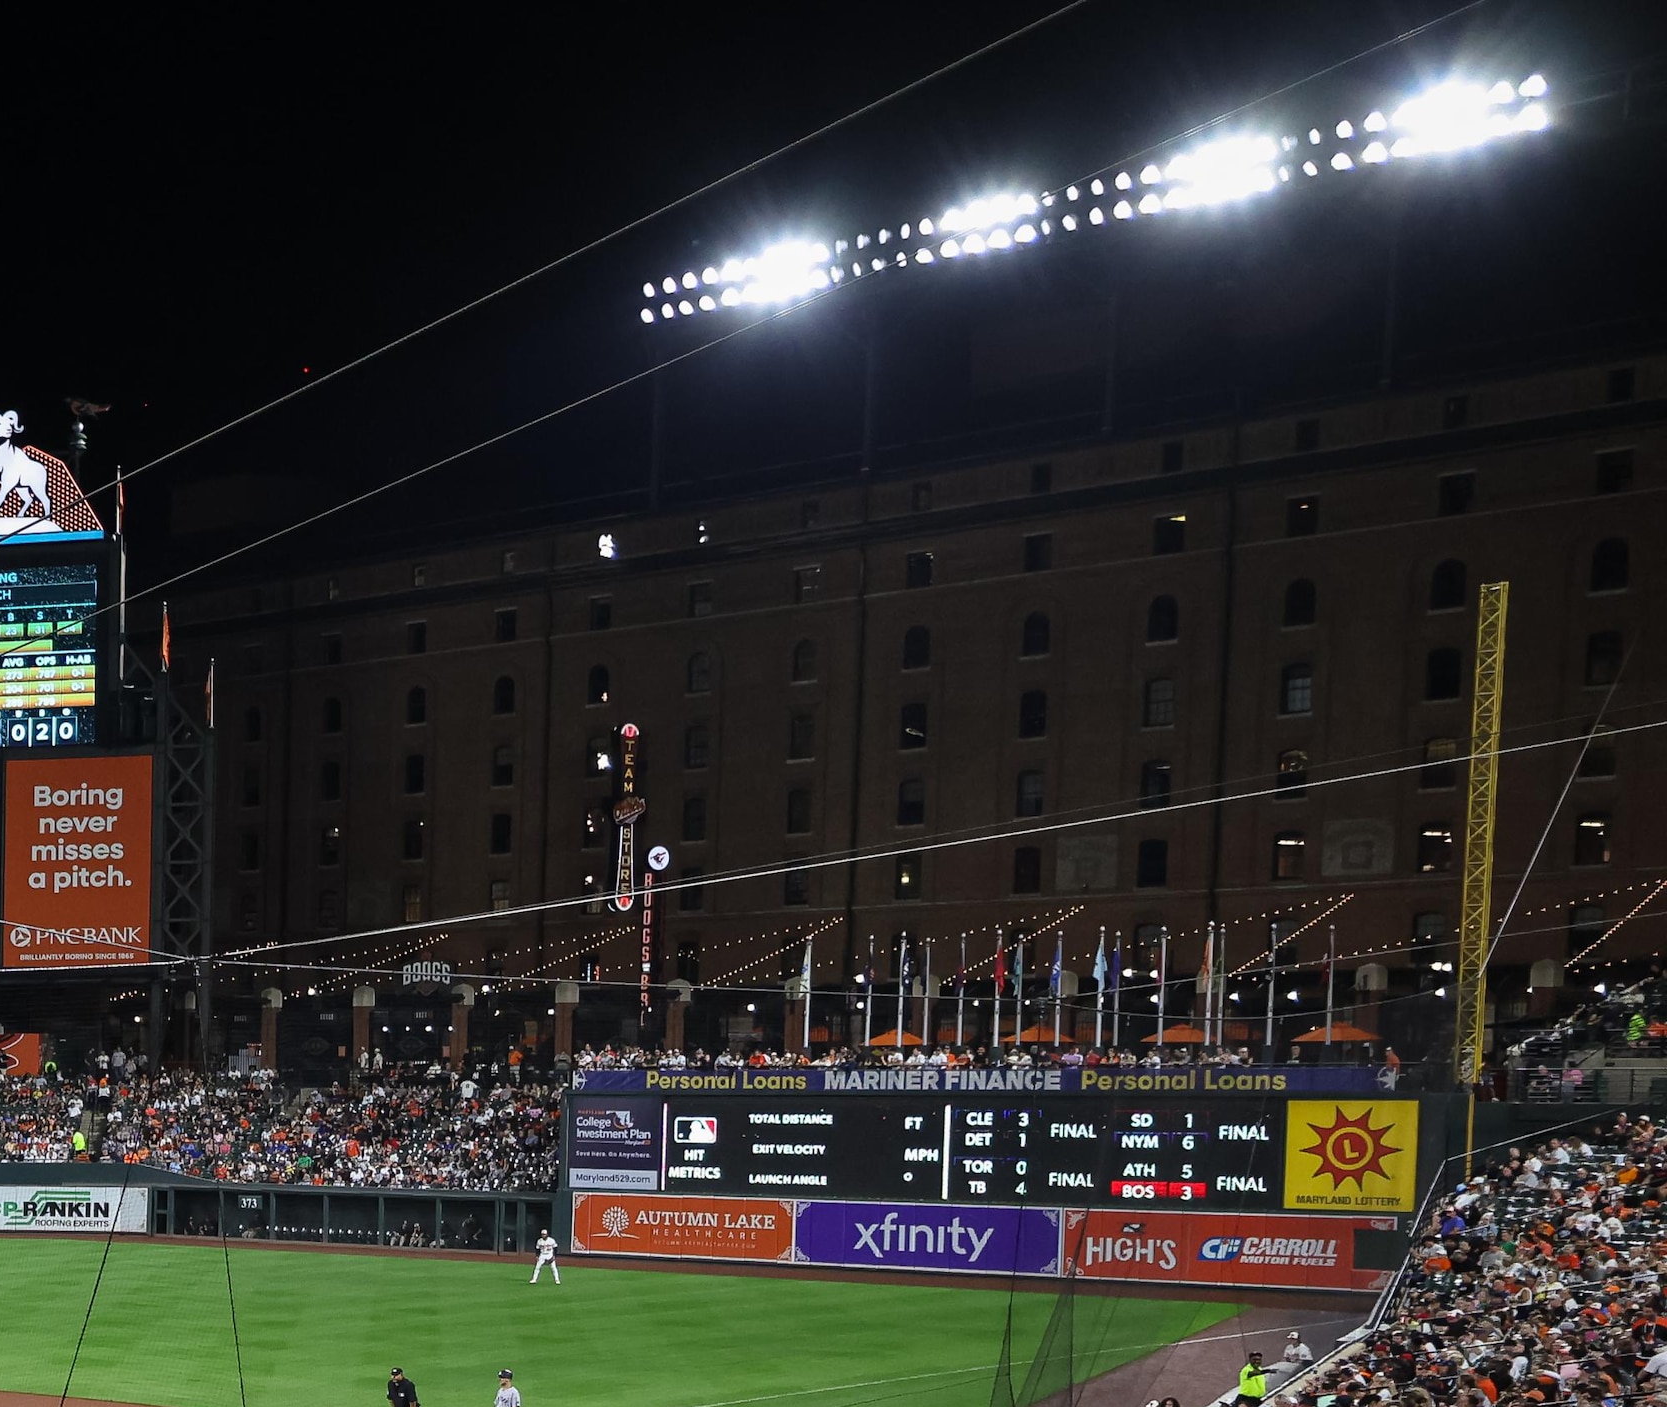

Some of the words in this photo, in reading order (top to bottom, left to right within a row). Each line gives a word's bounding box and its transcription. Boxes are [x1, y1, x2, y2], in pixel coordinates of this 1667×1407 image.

[625, 740, 635, 793] TEAM
[33, 782, 123, 810] Boring
[39, 815, 117, 834] never
[31, 838, 124, 861] misses
[28, 872, 46, 888] a
[54, 865, 132, 893] pitch.
[646, 1071, 736, 1090] Personal
[743, 1072, 807, 1090] Loans
[824, 1071, 939, 1090] MARINER
[945, 1071, 1061, 1090] FINANCE
[1081, 1070, 1195, 1090] Personal
[1205, 1072, 1287, 1090] Loans
[576, 1116, 612, 1129] College
[749, 1114, 781, 1125] TOTAL
[783, 1114, 833, 1125] DISTANCE
[904, 1116, 923, 1130] FT
[966, 1112, 993, 1126] CLE
[1131, 1114, 1153, 1128] SD
[576, 1128, 627, 1139] Investment
[630, 1129, 651, 1139] Plan
[1050, 1124, 1097, 1138] FINAL
[1218, 1125, 1269, 1141] FINAL
[965, 1133, 992, 1147] DET
[1121, 1135, 1159, 1149] NYM
[684, 1150, 705, 1161] HIT
[752, 1144, 774, 1155] EXIT
[775, 1144, 826, 1156] VELOCITY
[904, 1148, 939, 1162] MPH
[668, 1166, 721, 1180] METRICS
[963, 1160, 993, 1174] TOR
[1122, 1163, 1156, 1177] ATH
[575, 1174, 651, 1185] Maryland529.com
[749, 1174, 790, 1185] LAUNCH
[791, 1175, 828, 1186] ANGLE
[1048, 1173, 1094, 1188] FINAL
[1216, 1176, 1267, 1192] FINAL
[968, 1180, 986, 1194] TB
[1122, 1185, 1155, 1199] BOS
[240, 1198, 257, 1209] 373
[1296, 1195, 1351, 1206] MARYLAND
[1355, 1195, 1401, 1206] LOTTERY
[35, 1219, 72, 1227] ROOFING
[73, 1219, 110, 1227] EXPERTS
[635, 1210, 718, 1227] AUTUMN
[724, 1212, 776, 1230] LAKE
[653, 1229, 757, 1240] HEALTHCARE
[853, 1212, 995, 1262] xfinity
[1086, 1237, 1176, 1270] HIGH'S
[1243, 1237, 1338, 1258] CARROLL
[1240, 1256, 1288, 1265] MOTOR
[1293, 1257, 1336, 1267] FUELS
